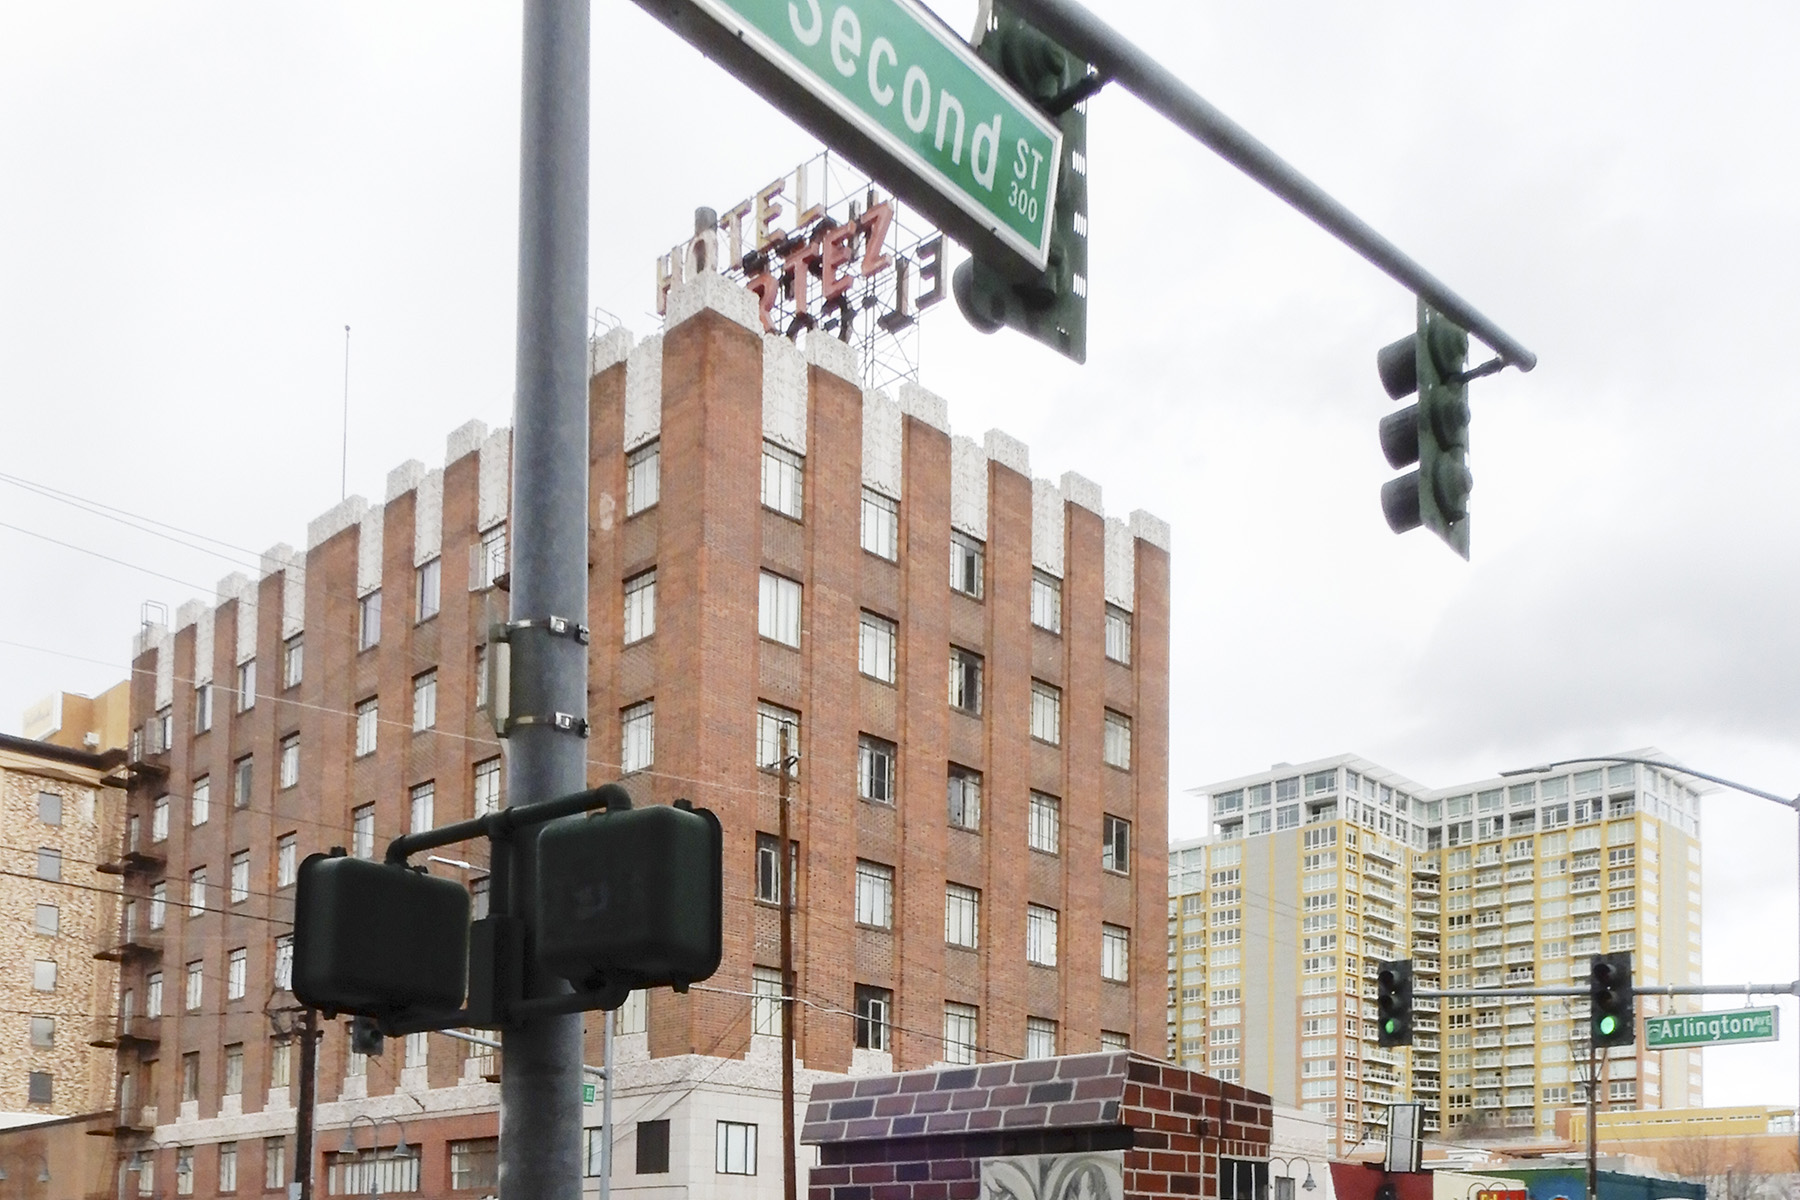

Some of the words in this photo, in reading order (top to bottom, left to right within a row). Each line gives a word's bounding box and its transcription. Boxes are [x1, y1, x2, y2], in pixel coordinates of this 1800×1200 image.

[1013, 137, 1044, 191] ST
[1008, 180, 1038, 223] 300
[1660, 1015, 1755, 1040] Arlington
